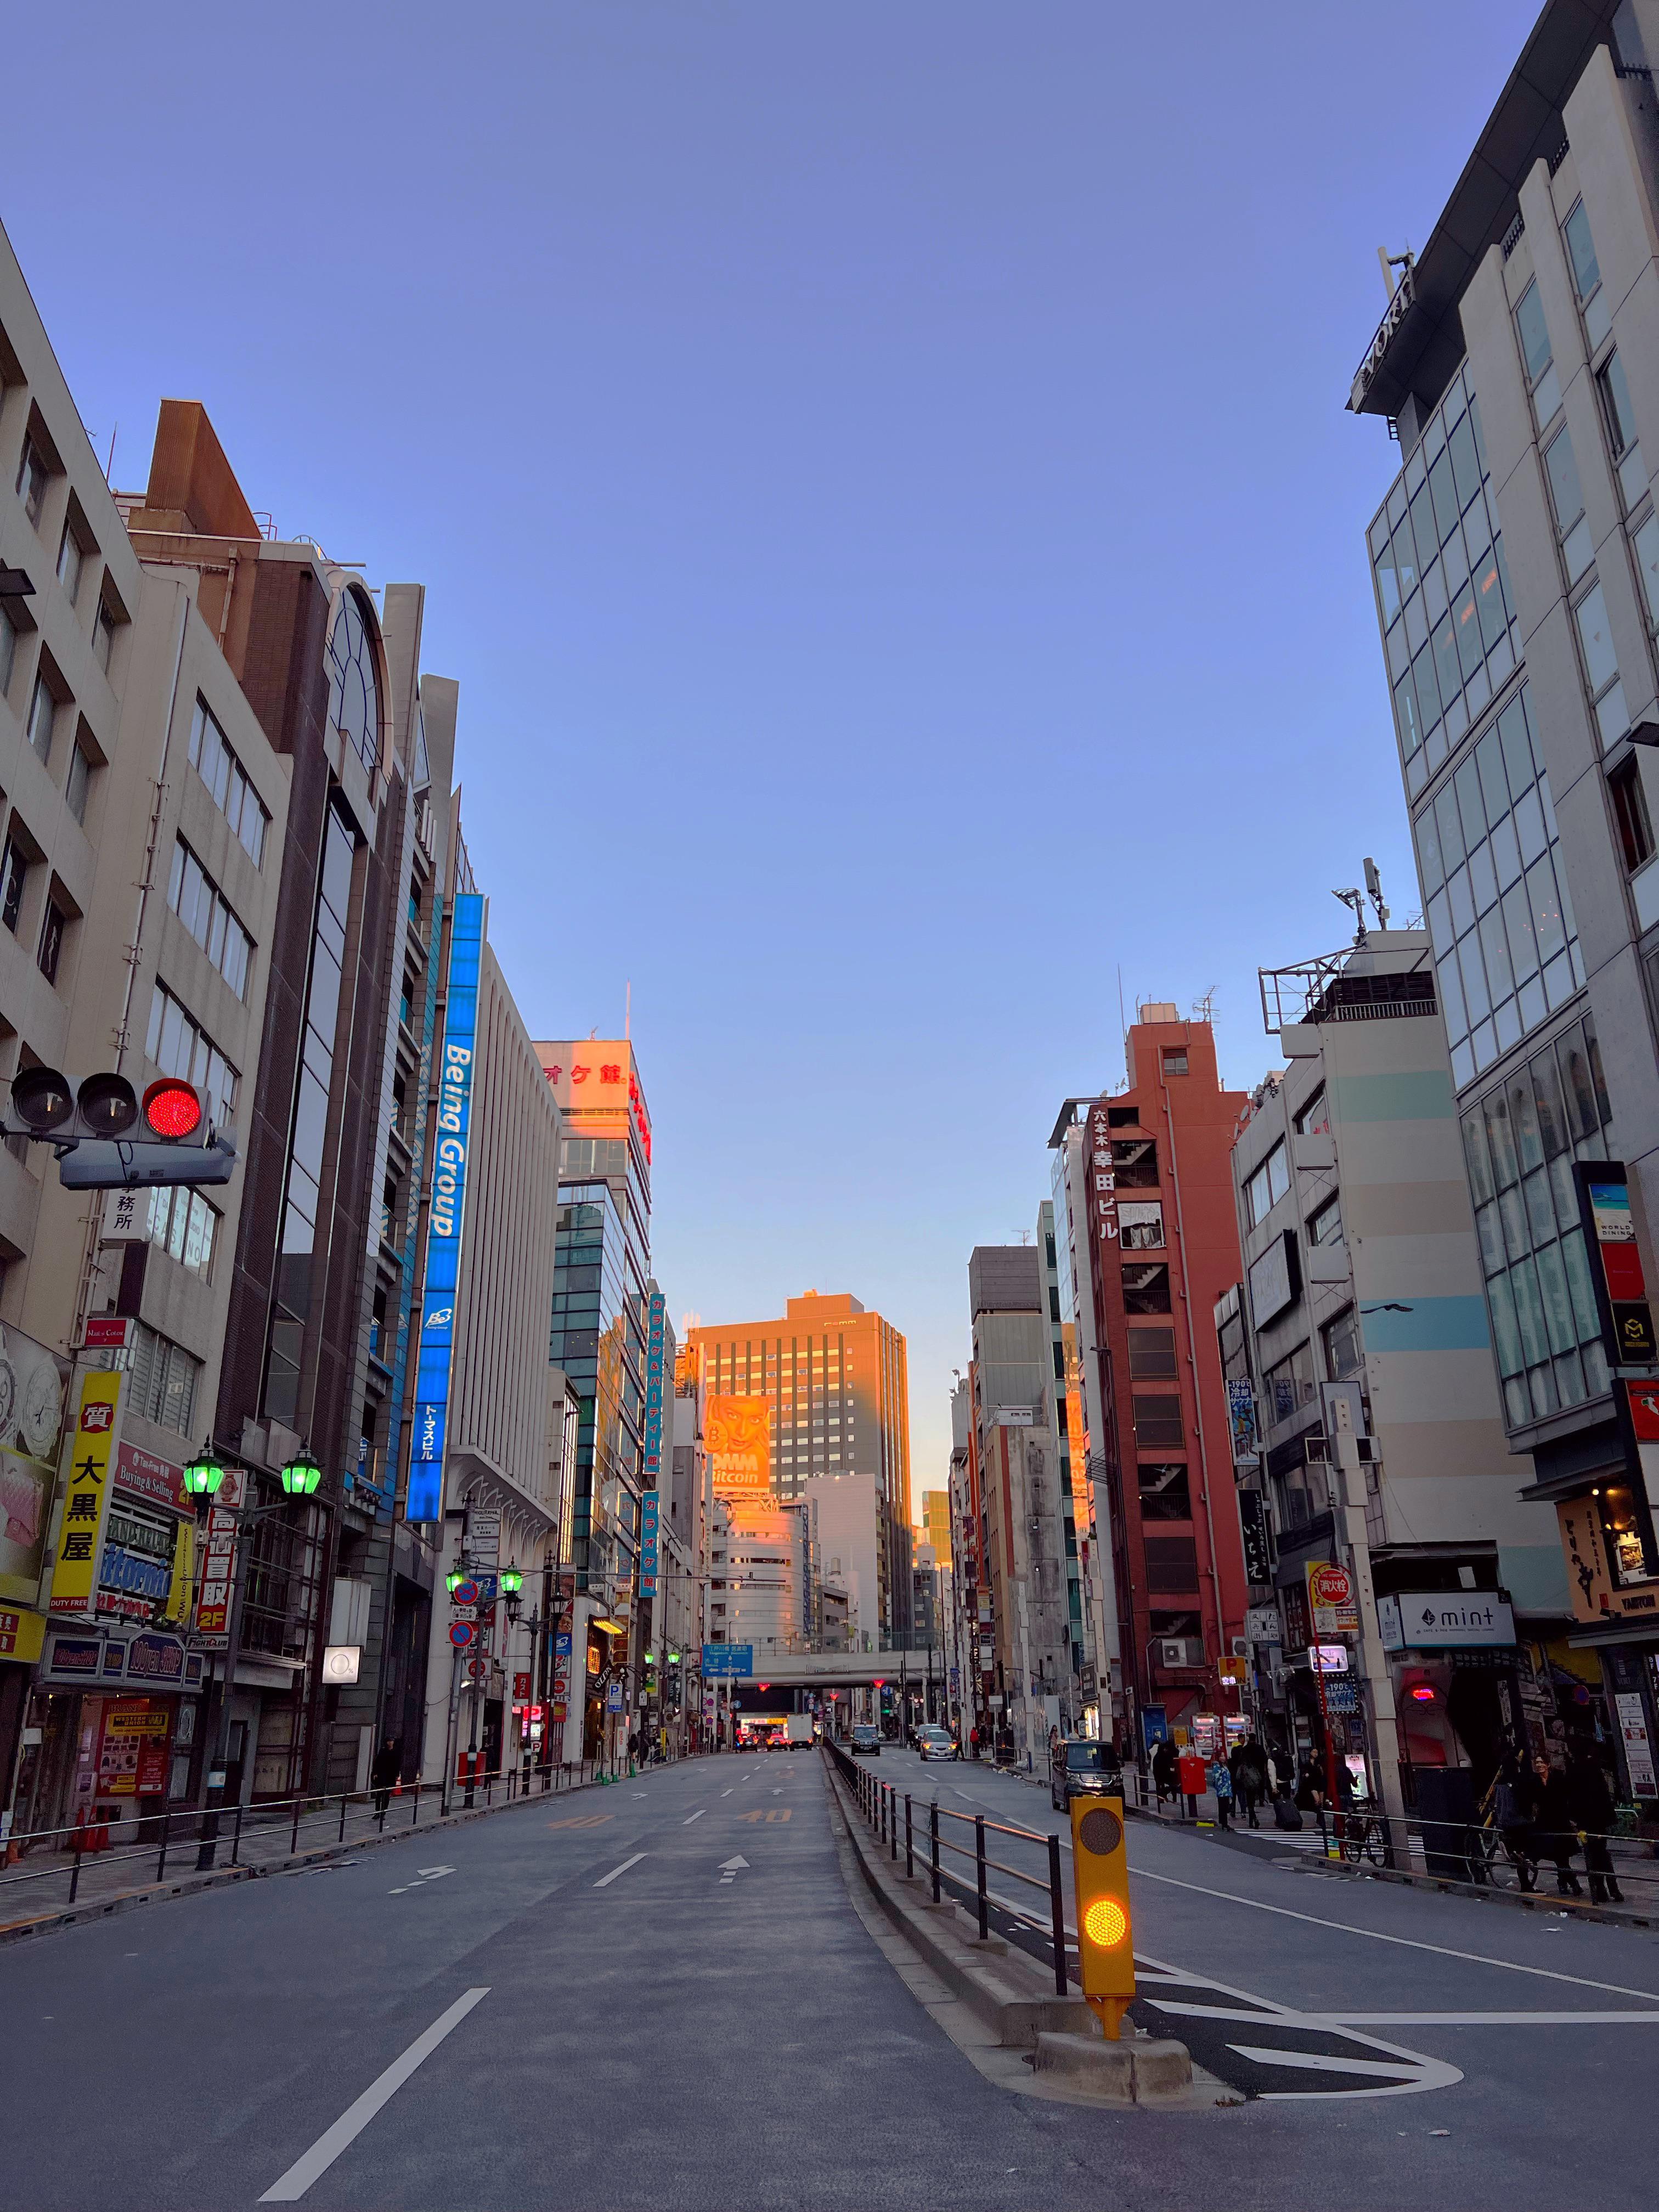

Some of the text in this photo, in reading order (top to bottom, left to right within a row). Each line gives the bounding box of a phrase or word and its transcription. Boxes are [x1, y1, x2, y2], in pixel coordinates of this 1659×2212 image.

[429, 1043, 472, 1237] Being Group
[1093, 1110, 1119, 1239] 六本木幸田ビル
[647, 1300, 662, 1466] カラオケ&パーティー館
[1231, 1388, 1249, 1398] 冷却
[1230, 1397, 1250, 1406] サウナ
[84, 1406, 111, 1428] 質
[421, 1405, 437, 1460] トーマスビル
[120, 1465, 174, 1503] Buying & Selling
[60, 1455, 105, 1562] 大黒屋
[643, 1500, 656, 1588] カラオケ館
[1243, 1523, 1263, 1579] いちえ
[1319, 1579, 1347, 1593] 消火栓
[177, 1600, 186, 1620] WU
[199, 1612, 225, 1627] 2F
[1441, 1607, 1494, 1626] mint
[1226, 1658, 1237, 1671] P
[611, 1685, 619, 1696] P
[533, 1743, 540, 1751] P
[733, 1809, 793, 1824] 40
